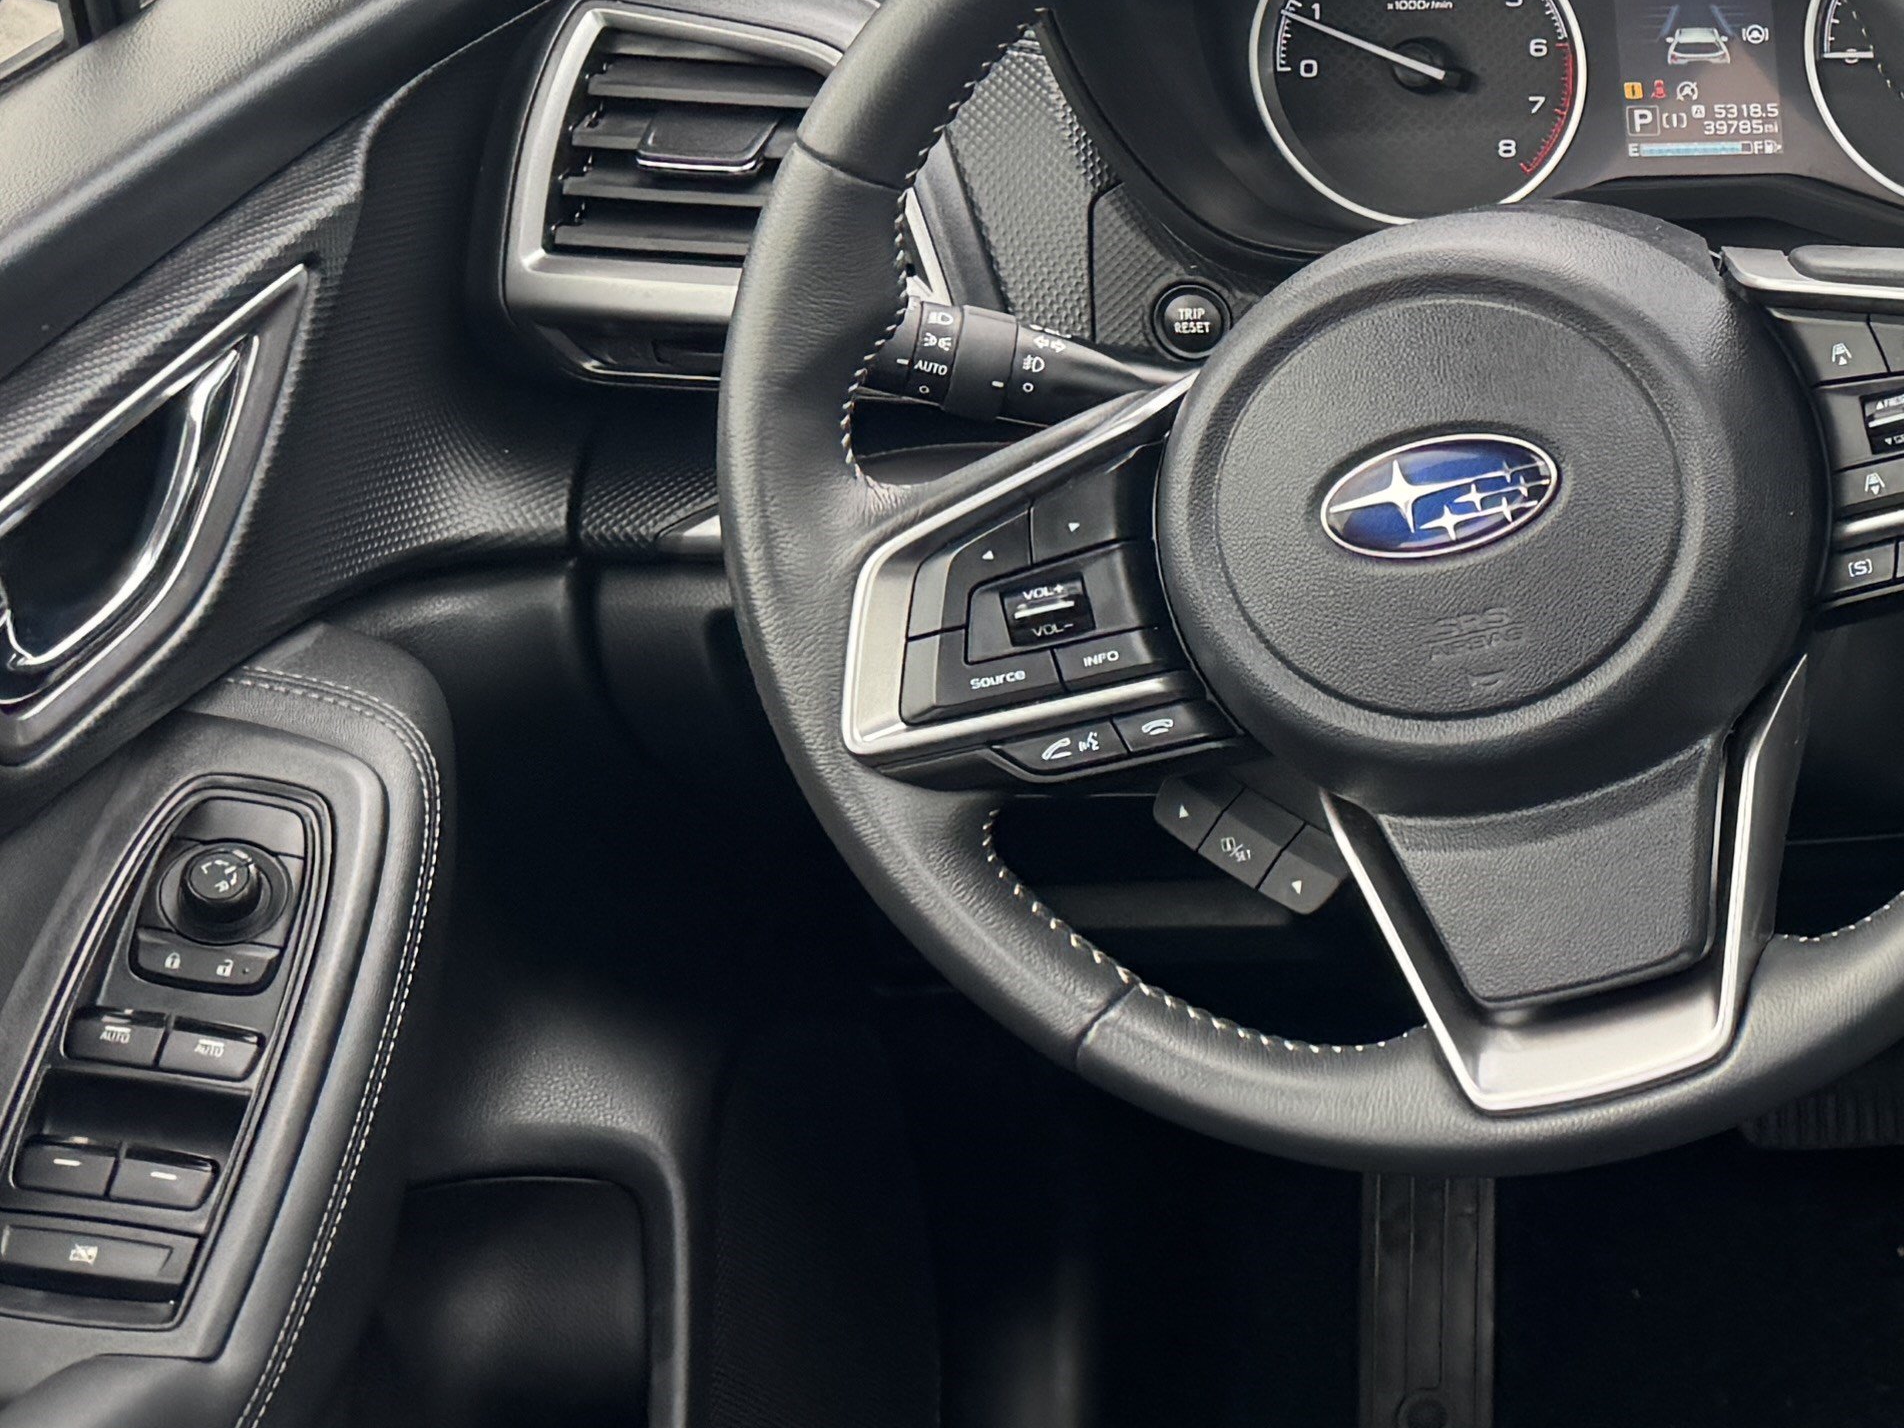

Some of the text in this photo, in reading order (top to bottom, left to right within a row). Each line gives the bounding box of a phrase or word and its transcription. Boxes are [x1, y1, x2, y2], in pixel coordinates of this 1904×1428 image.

[1311, 2, 1321, 21] 1
[1529, 38, 1548, 58] 6
[1300, 59, 1318, 78] 0
[1528, 95, 1546, 115] 7
[1633, 108, 1654, 133] P
[1713, 102, 1780, 119] 5318.5
[1497, 139, 1517, 159] 8
[1177, 307, 1206, 322] TRIP
[1173, 320, 1212, 335] RESET
[914, 358, 949, 377] AUTO
[1083, 649, 1120, 668] INFO
